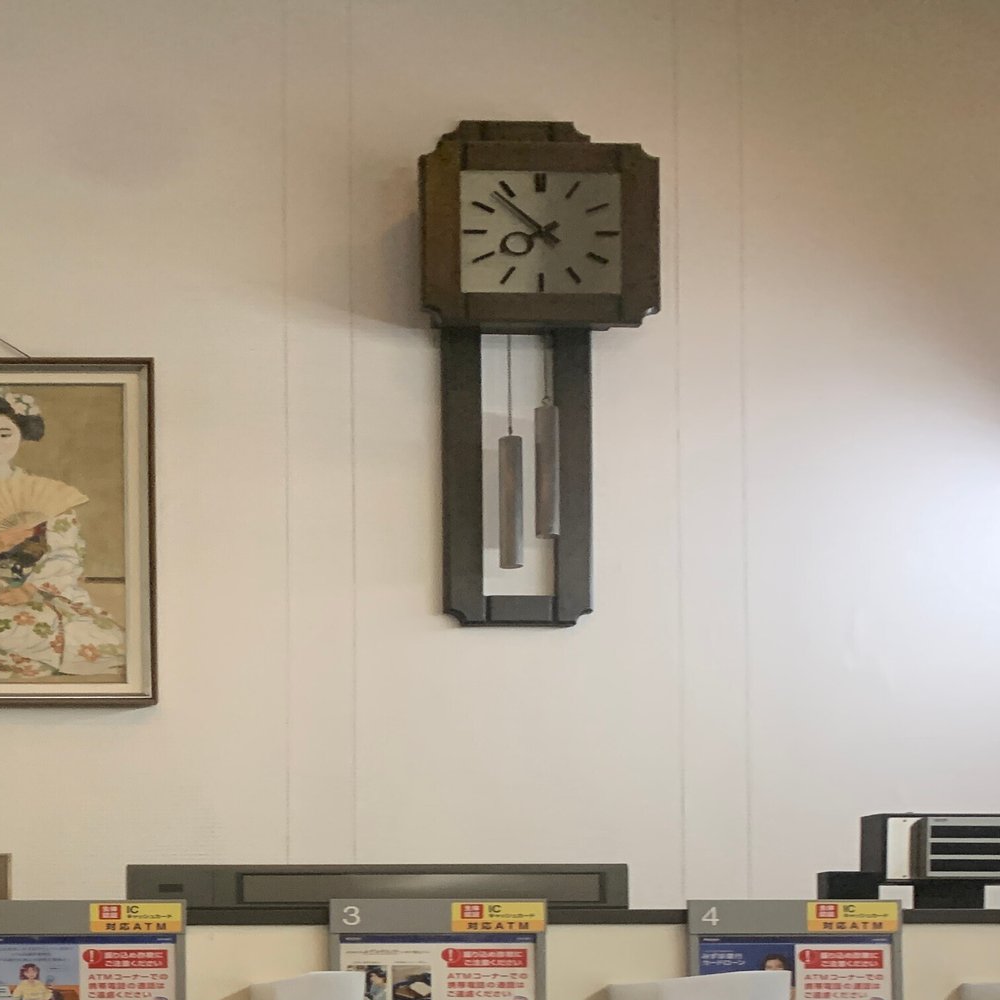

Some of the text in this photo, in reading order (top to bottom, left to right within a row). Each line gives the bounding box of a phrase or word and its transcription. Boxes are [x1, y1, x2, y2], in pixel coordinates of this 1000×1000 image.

[126, 905, 139, 914] IC
[488, 904, 502, 913] IC
[843, 904, 856, 913] IC
[342, 906, 361, 925] 3
[701, 907, 720, 925] 4
